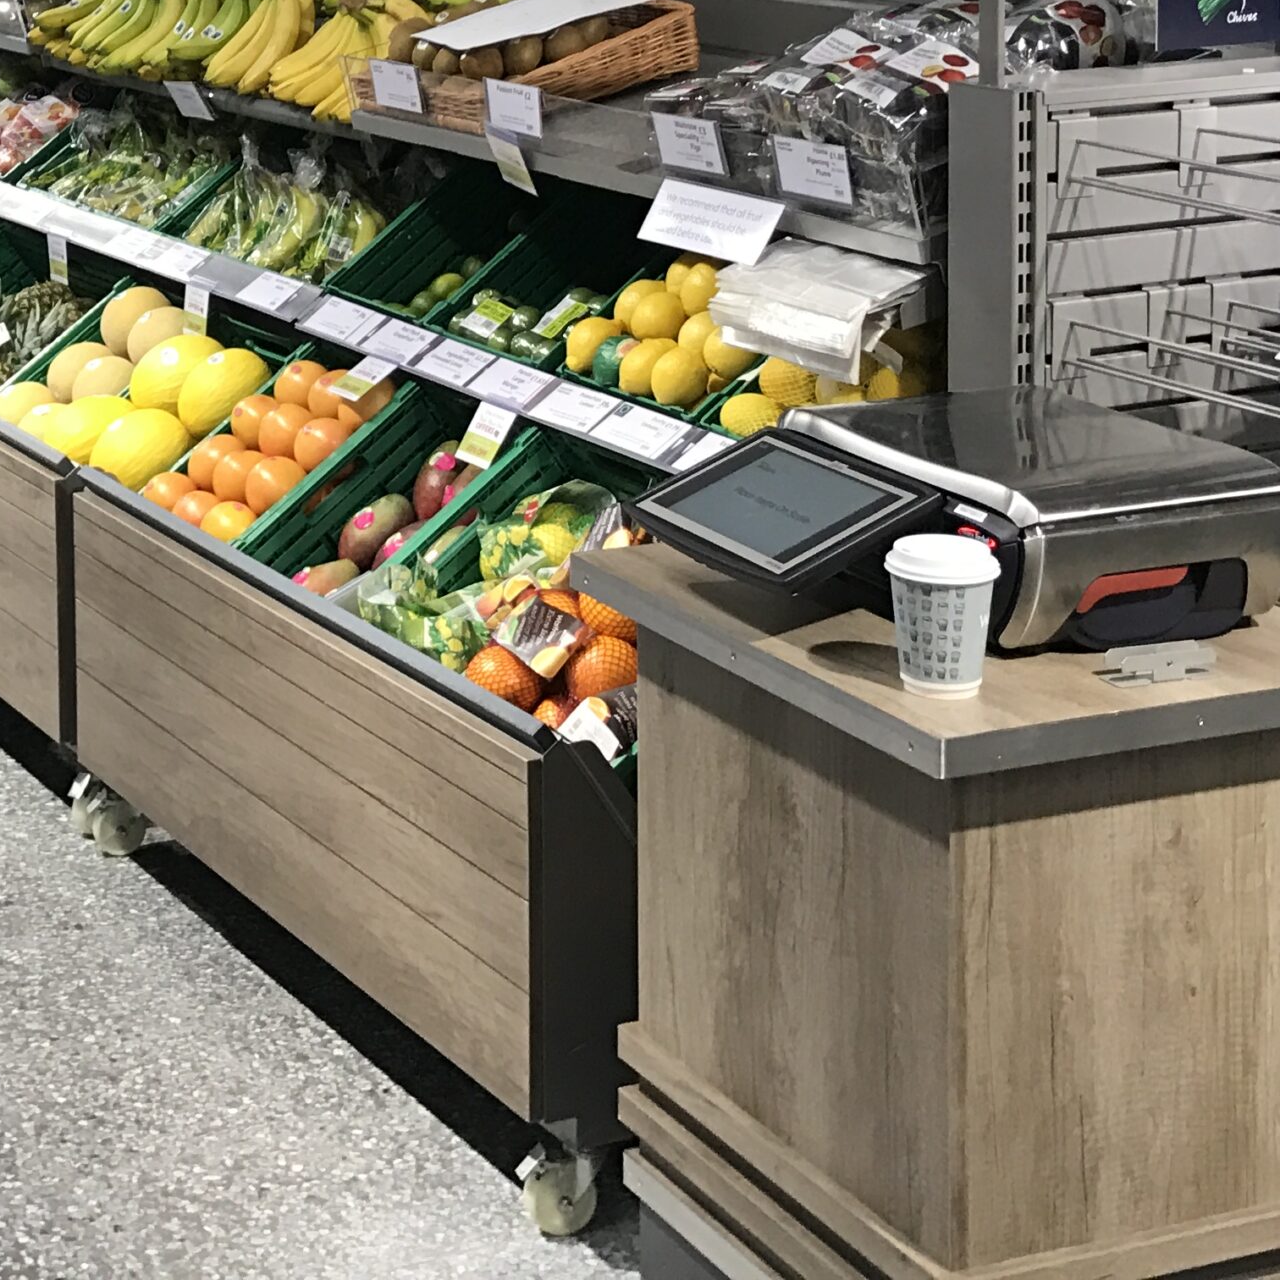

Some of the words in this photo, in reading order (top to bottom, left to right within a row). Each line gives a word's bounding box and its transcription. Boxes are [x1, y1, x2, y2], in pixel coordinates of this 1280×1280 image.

[1226, 9, 1258, 24] Chives
[676, 195, 721, 212] recommend
[718, 203, 738, 216] that
